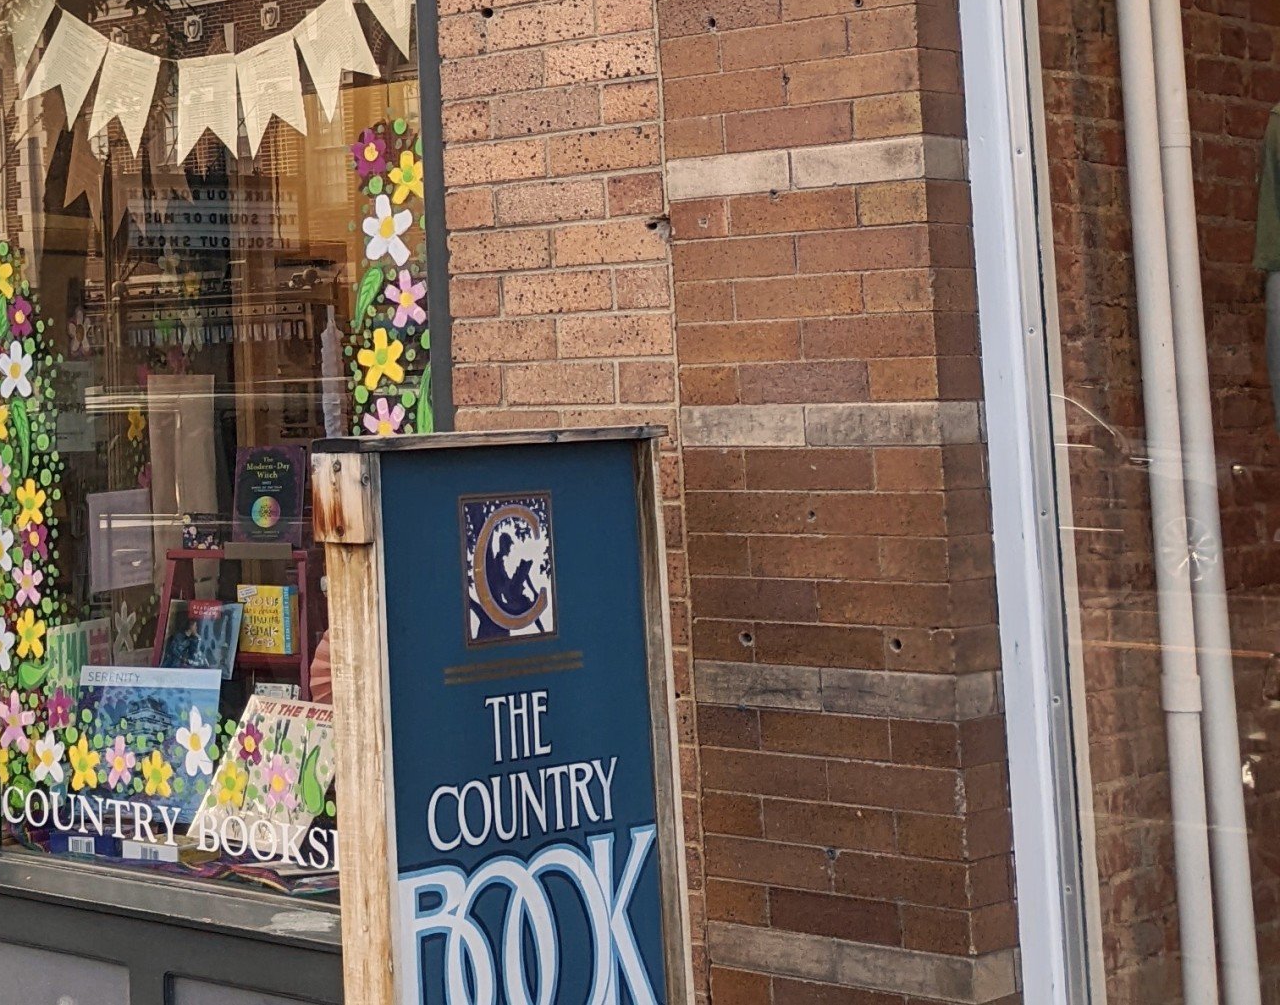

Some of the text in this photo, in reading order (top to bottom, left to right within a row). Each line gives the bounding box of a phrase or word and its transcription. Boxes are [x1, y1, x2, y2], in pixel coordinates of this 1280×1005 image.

[257, 471, 278, 479] Witch
[87, 671, 142, 683] SERENITY
[278, 703, 305, 717] THE
[485, 691, 553, 763] THE
[2, 785, 181, 846] COUNTRY
[427, 756, 619, 852] COUNTRY
[398, 824, 659, 1005] BOOK
